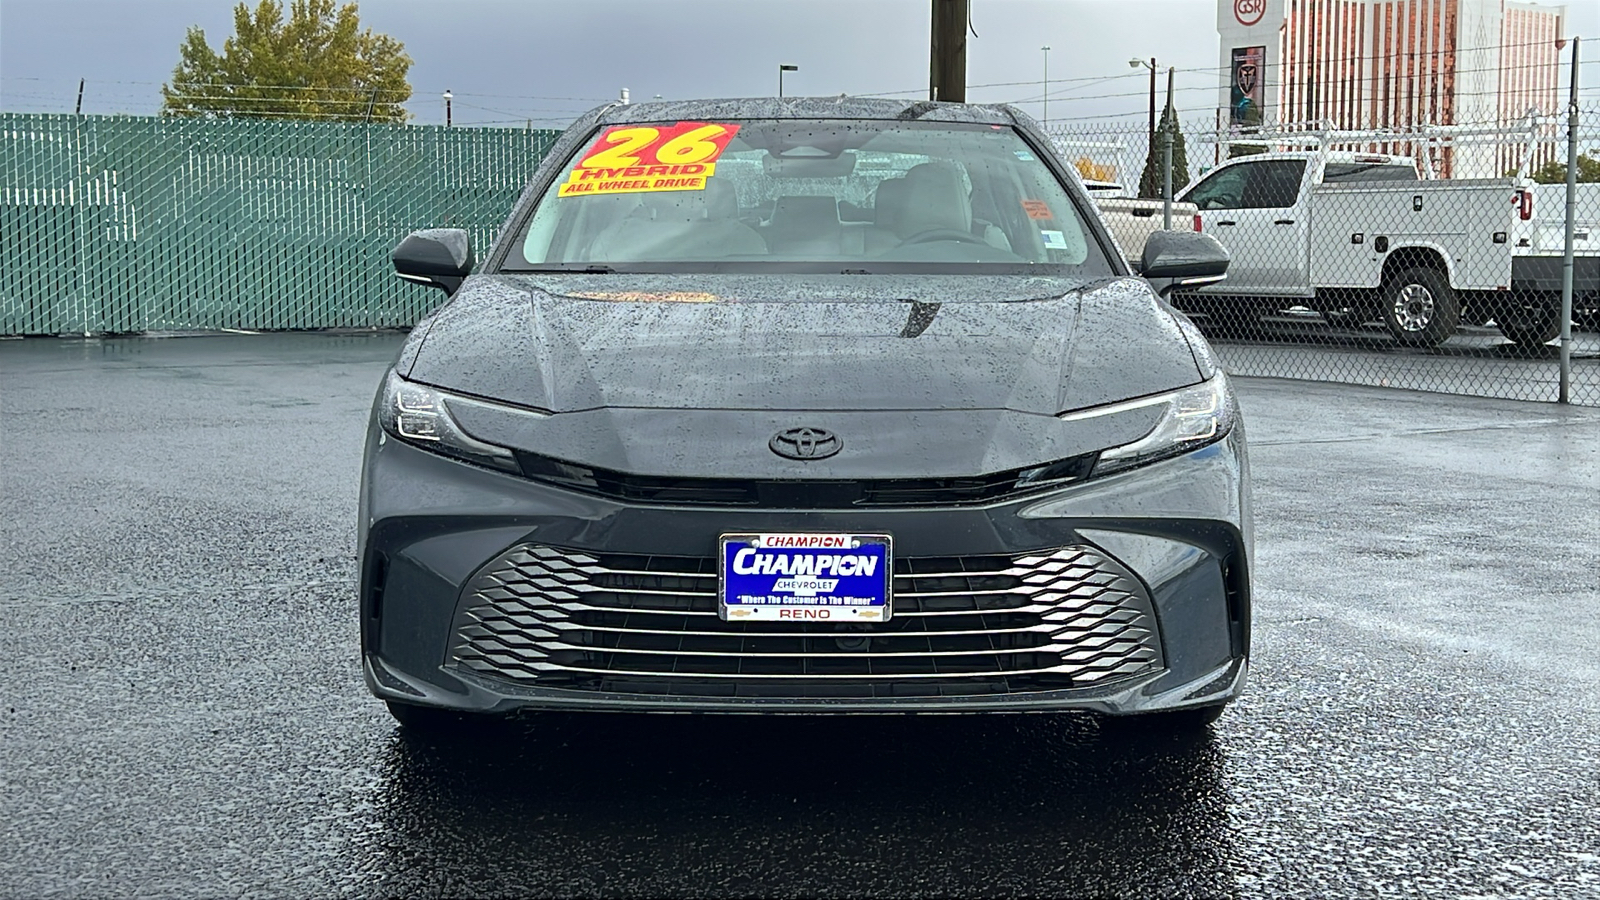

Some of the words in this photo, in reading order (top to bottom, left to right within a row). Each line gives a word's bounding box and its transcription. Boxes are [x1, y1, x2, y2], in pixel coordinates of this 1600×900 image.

[1238, 0, 1261, 14] GSR
[581, 124, 727, 168] 26
[579, 164, 706, 180] HYBRID
[564, 183, 594, 193] ALL
[598, 179, 651, 191] WHEEL
[653, 177, 703, 188] DRIVE
[766, 536, 845, 547] CHAMPION
[777, 581, 833, 589] CHEVROLET
[767, 595, 781, 604] The
[783, 595, 819, 605] Customer
[828, 596, 842, 605] The
[779, 609, 831, 619] RENO
